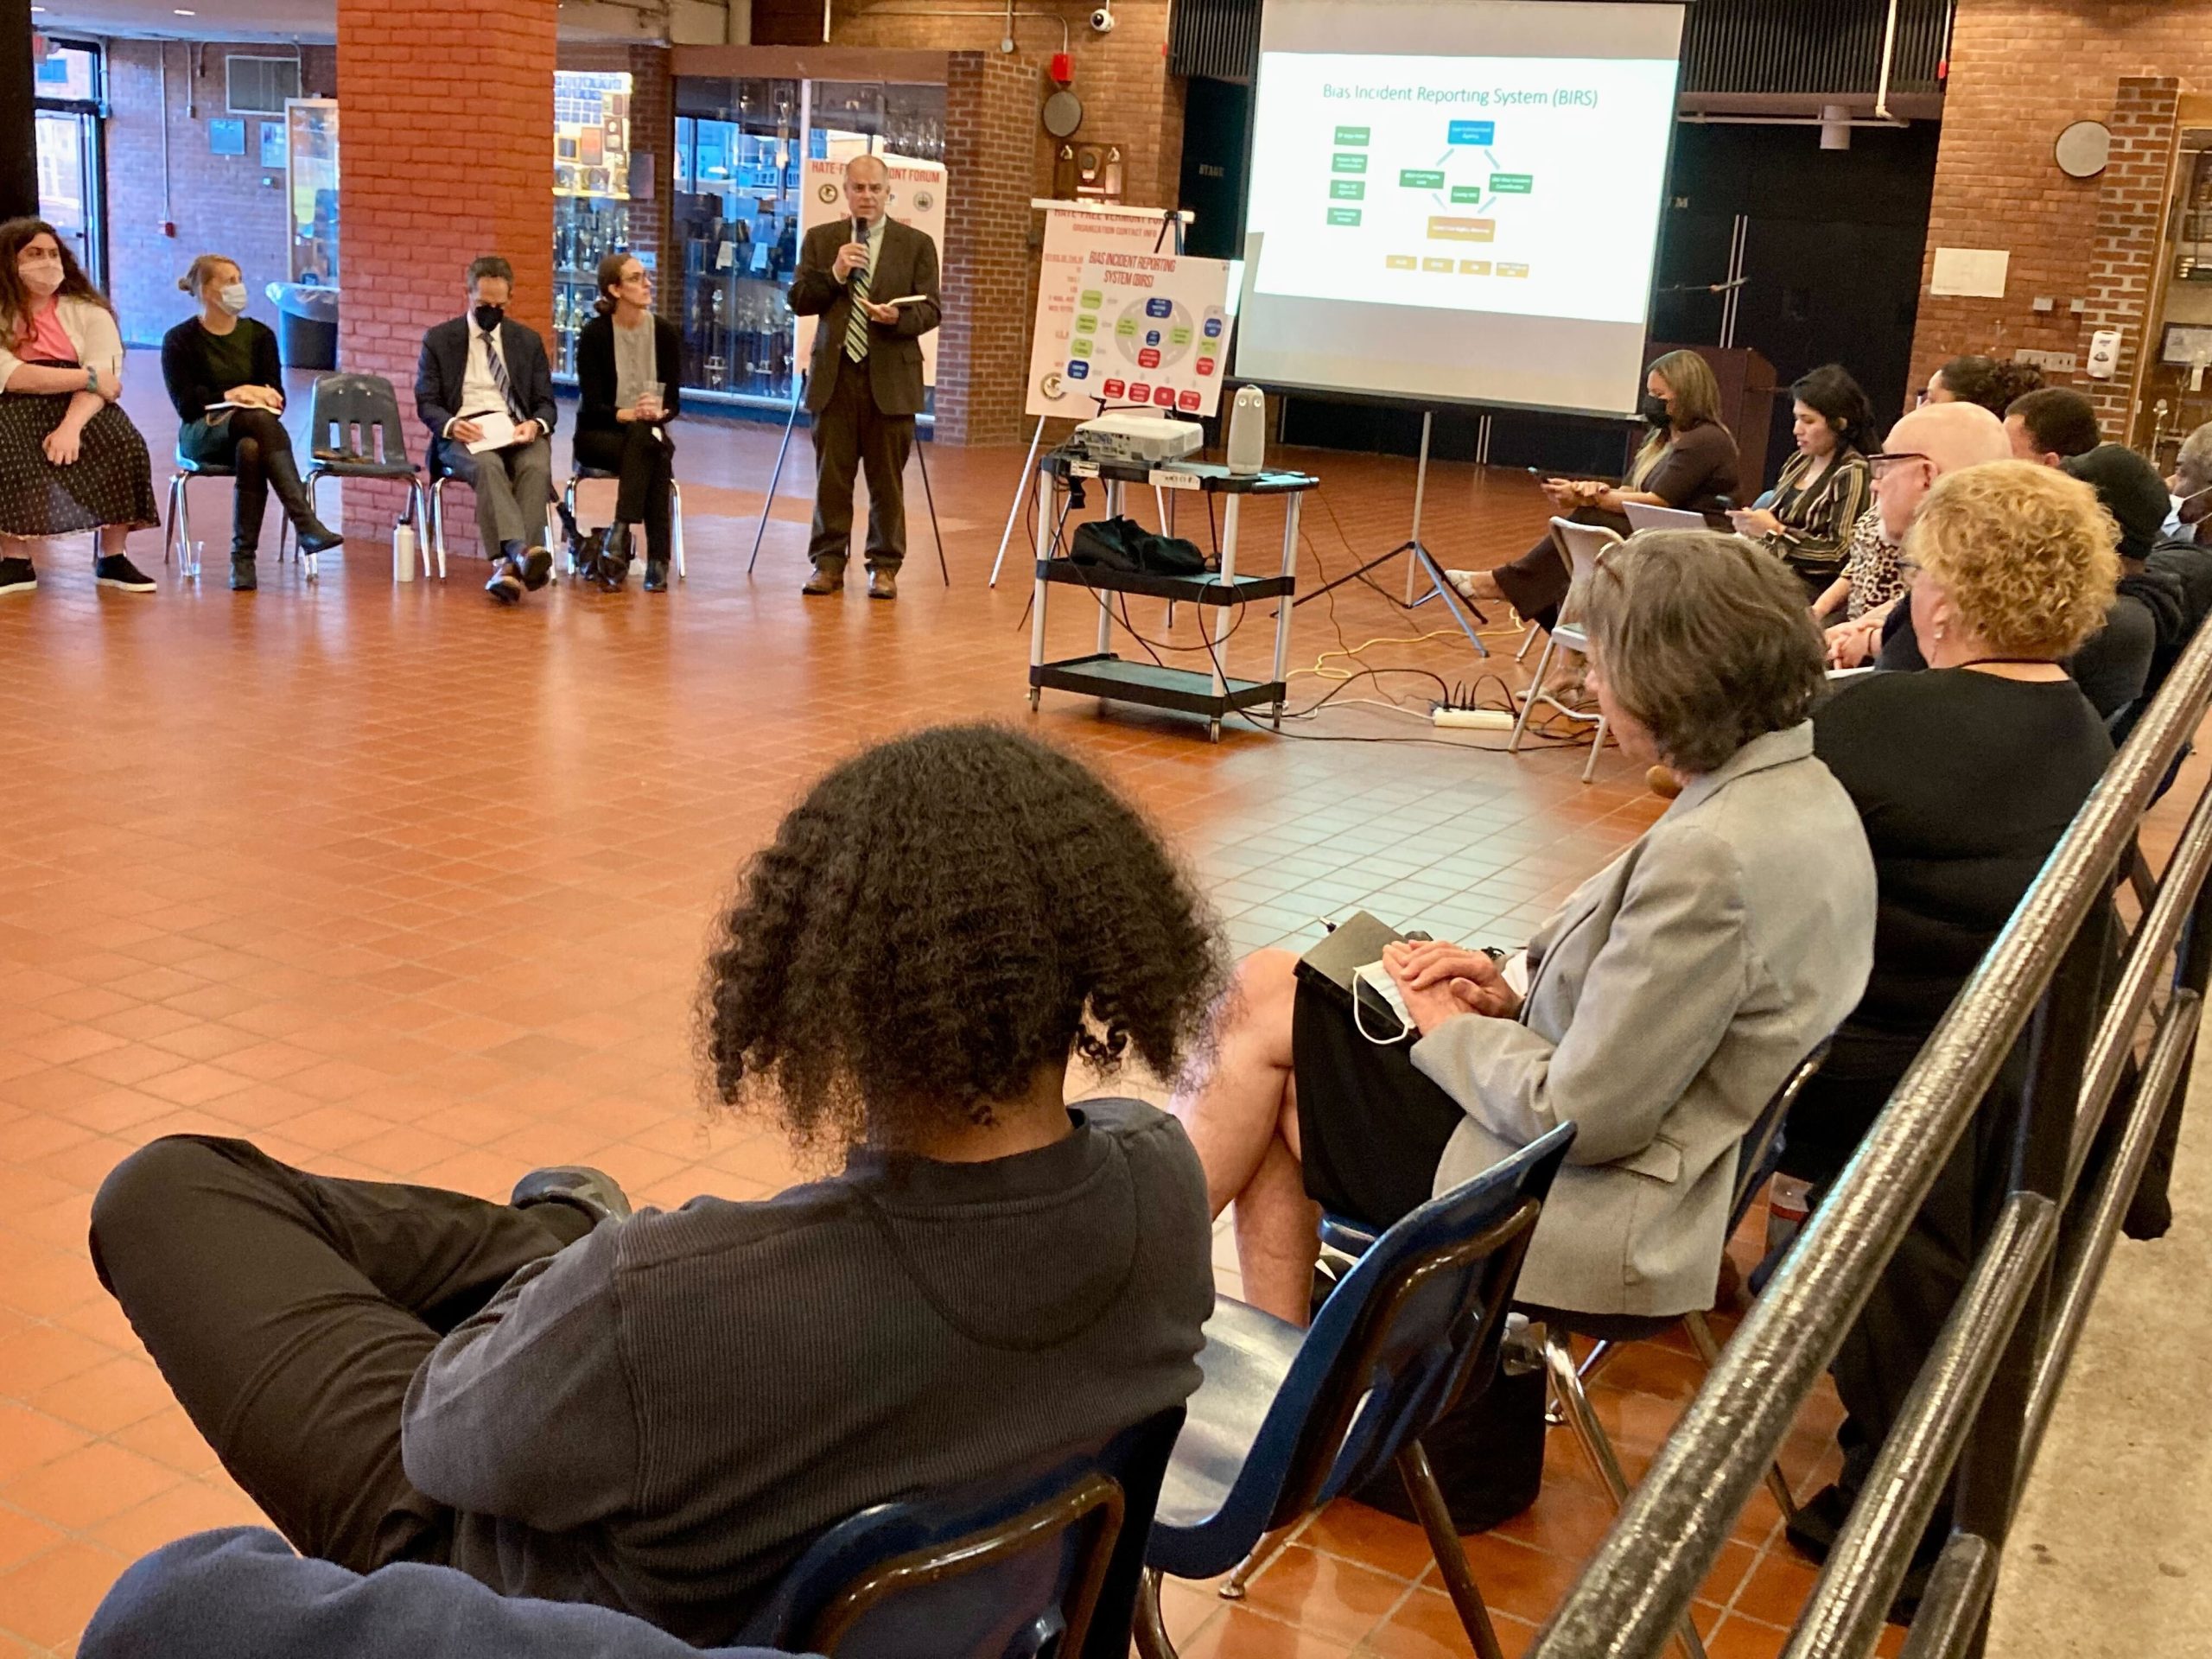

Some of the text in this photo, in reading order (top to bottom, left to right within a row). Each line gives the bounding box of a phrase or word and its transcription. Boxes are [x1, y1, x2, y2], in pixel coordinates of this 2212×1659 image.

[1323, 84, 1598, 109] Bias Incident Reporting System (BIRS)
[811, 162, 845, 175] HATE-F
[909, 168, 940, 183] FORUM
[1116, 226, 1142, 237] CONTACT
[1089, 251, 1106, 264] BIAS
[1106, 252, 1137, 269] INCIDENT
[1137, 256, 1176, 273] REPORTING
[1103, 270, 1154, 289] SYSTEM (BIRS)
